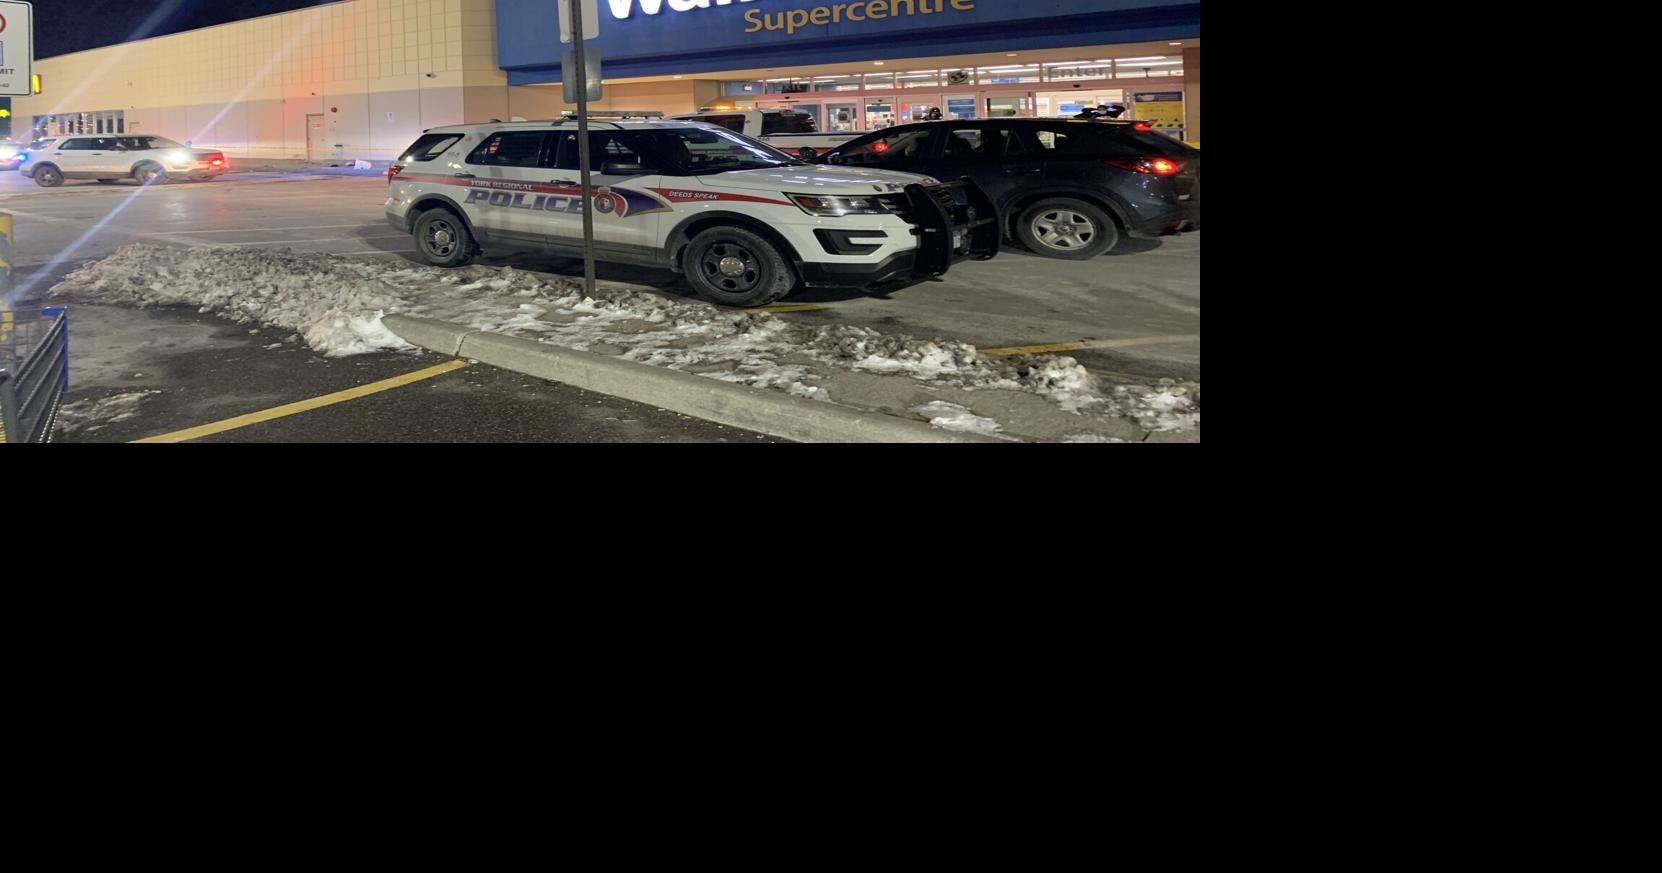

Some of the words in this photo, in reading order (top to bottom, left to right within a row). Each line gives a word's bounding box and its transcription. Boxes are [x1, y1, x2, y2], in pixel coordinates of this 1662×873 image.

[743, 0, 975, 34] Supercentre
[1047, 66, 1109, 79] Enter
[492, 182, 534, 191] REGIONAL
